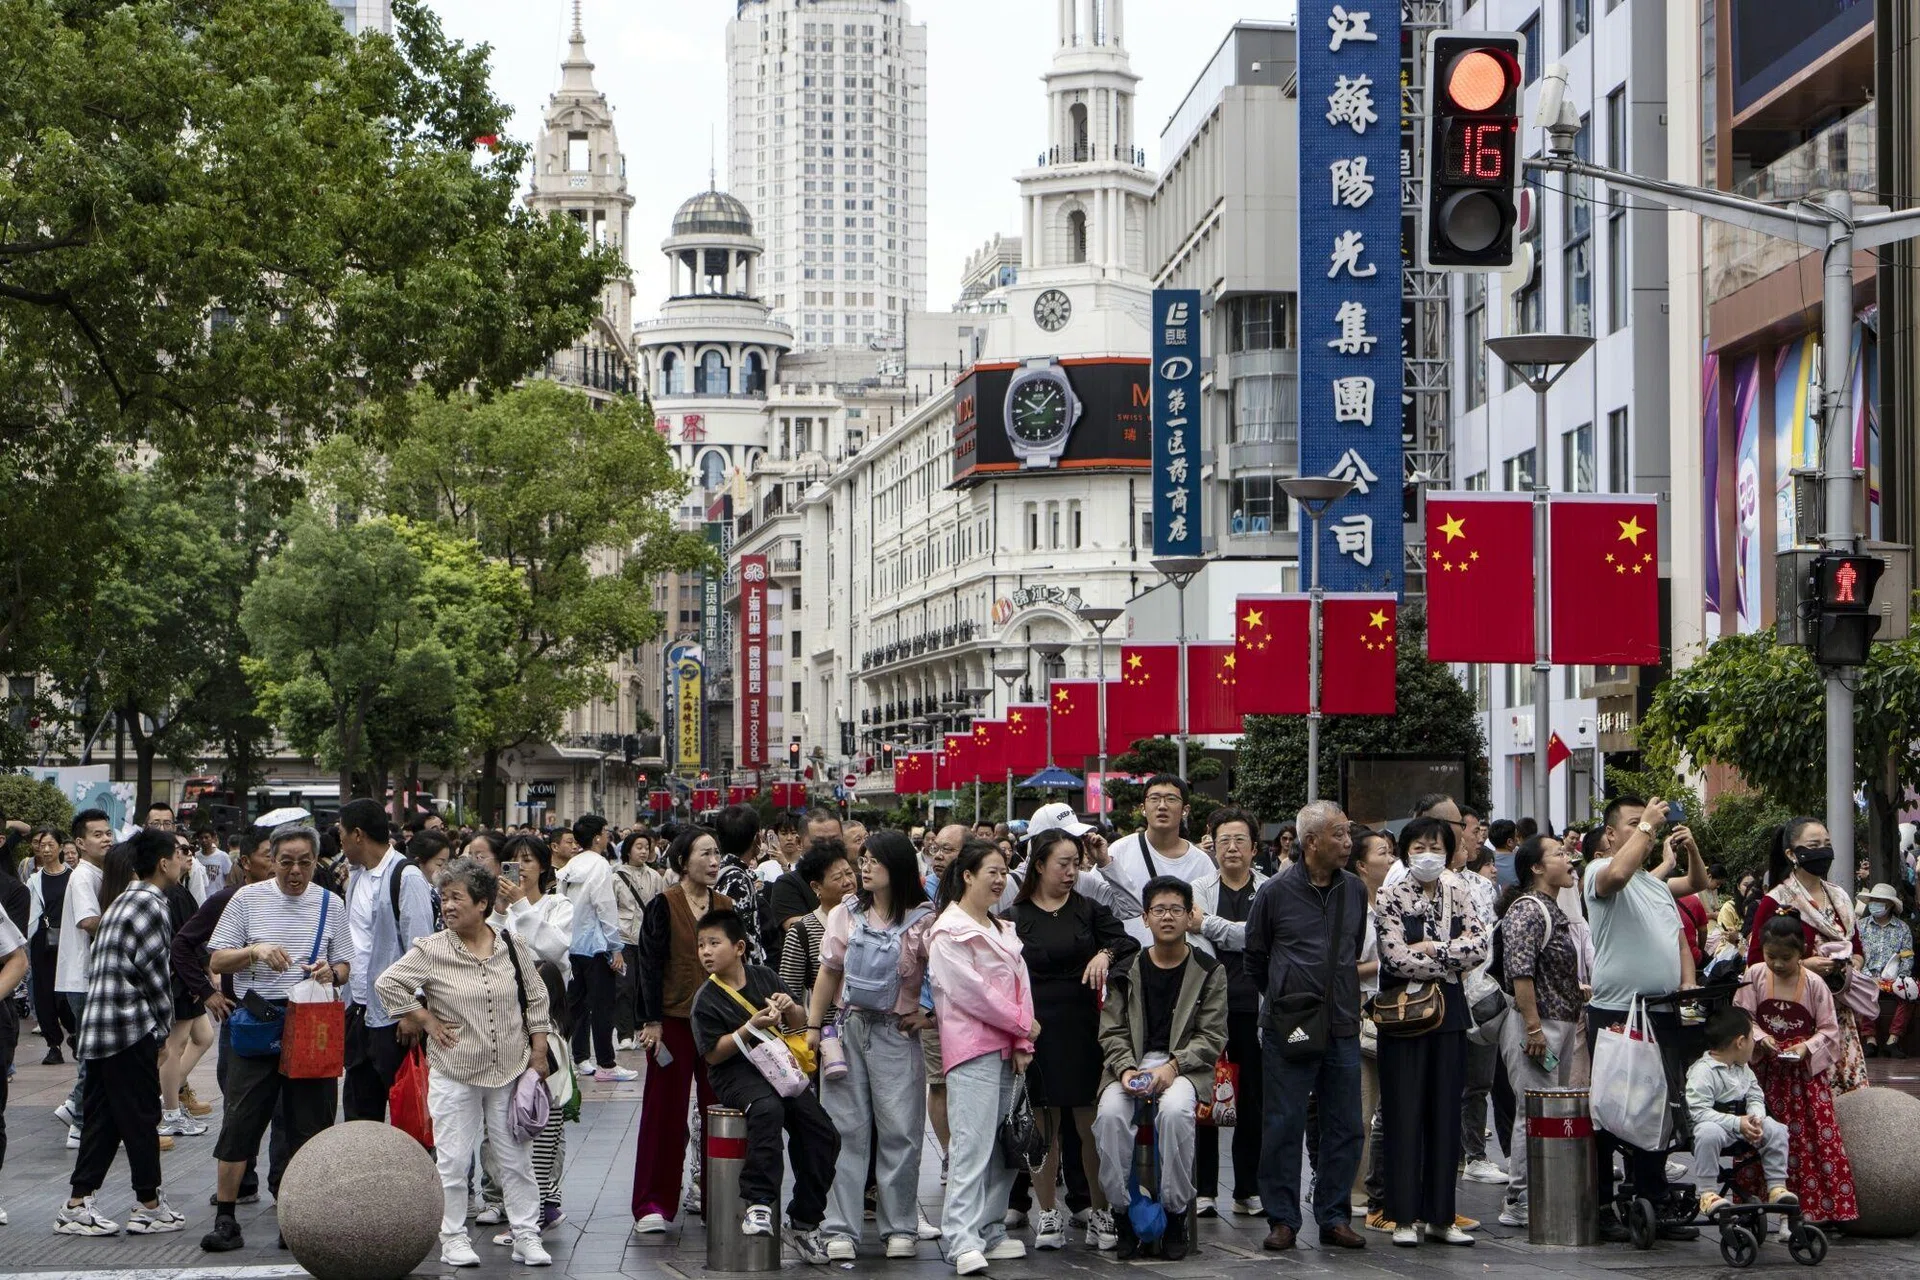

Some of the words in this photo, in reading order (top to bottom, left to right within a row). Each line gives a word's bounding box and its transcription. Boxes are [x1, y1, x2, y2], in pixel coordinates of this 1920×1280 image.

[1463, 125, 1501, 177] 16
[1325, 4, 1378, 567] 江蘇陽光集團公司
[1165, 387, 1189, 543] 第一医药商店
[749, 699, 760, 718] First
[749, 720, 760, 762] Foodhall
[1288, 1035, 1309, 1043] adidas
